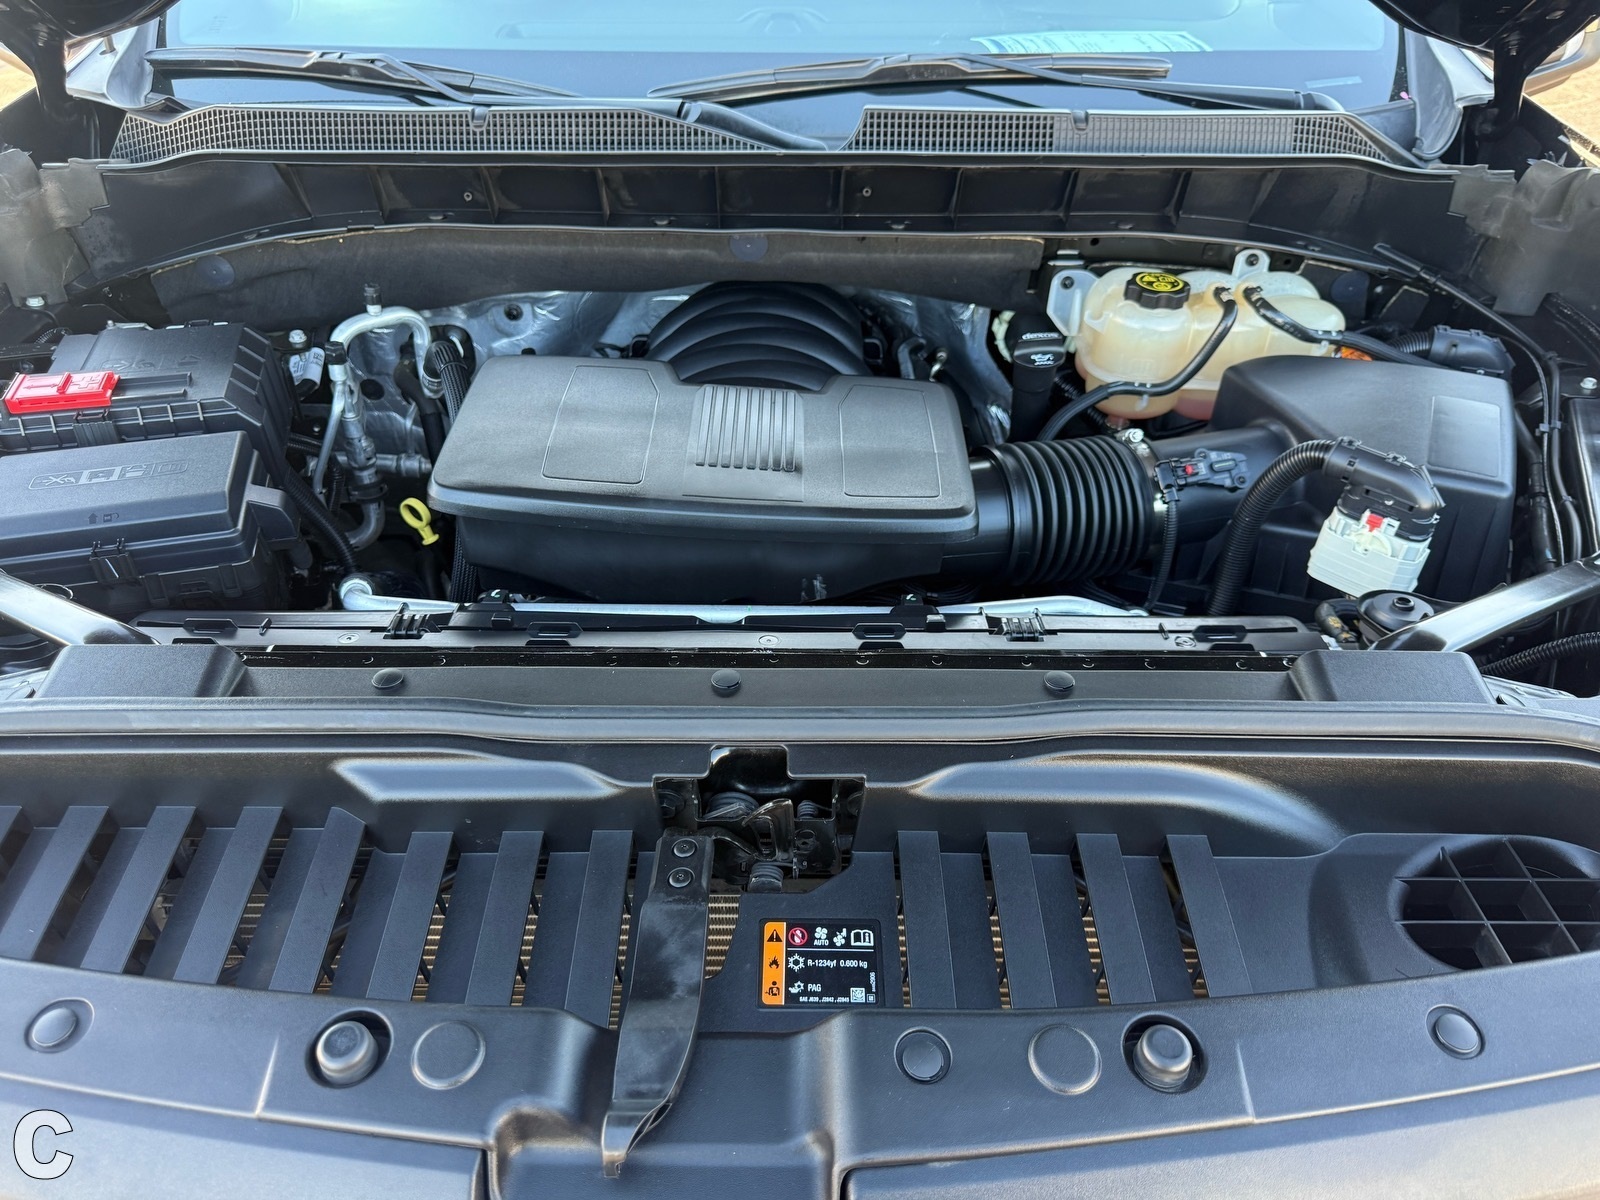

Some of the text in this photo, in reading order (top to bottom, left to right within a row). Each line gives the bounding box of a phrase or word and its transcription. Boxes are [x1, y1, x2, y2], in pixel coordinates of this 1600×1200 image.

[807, 959, 837, 969] R-1234yf
[859, 960, 868, 969] kg
[807, 983, 822, 992] PAG
